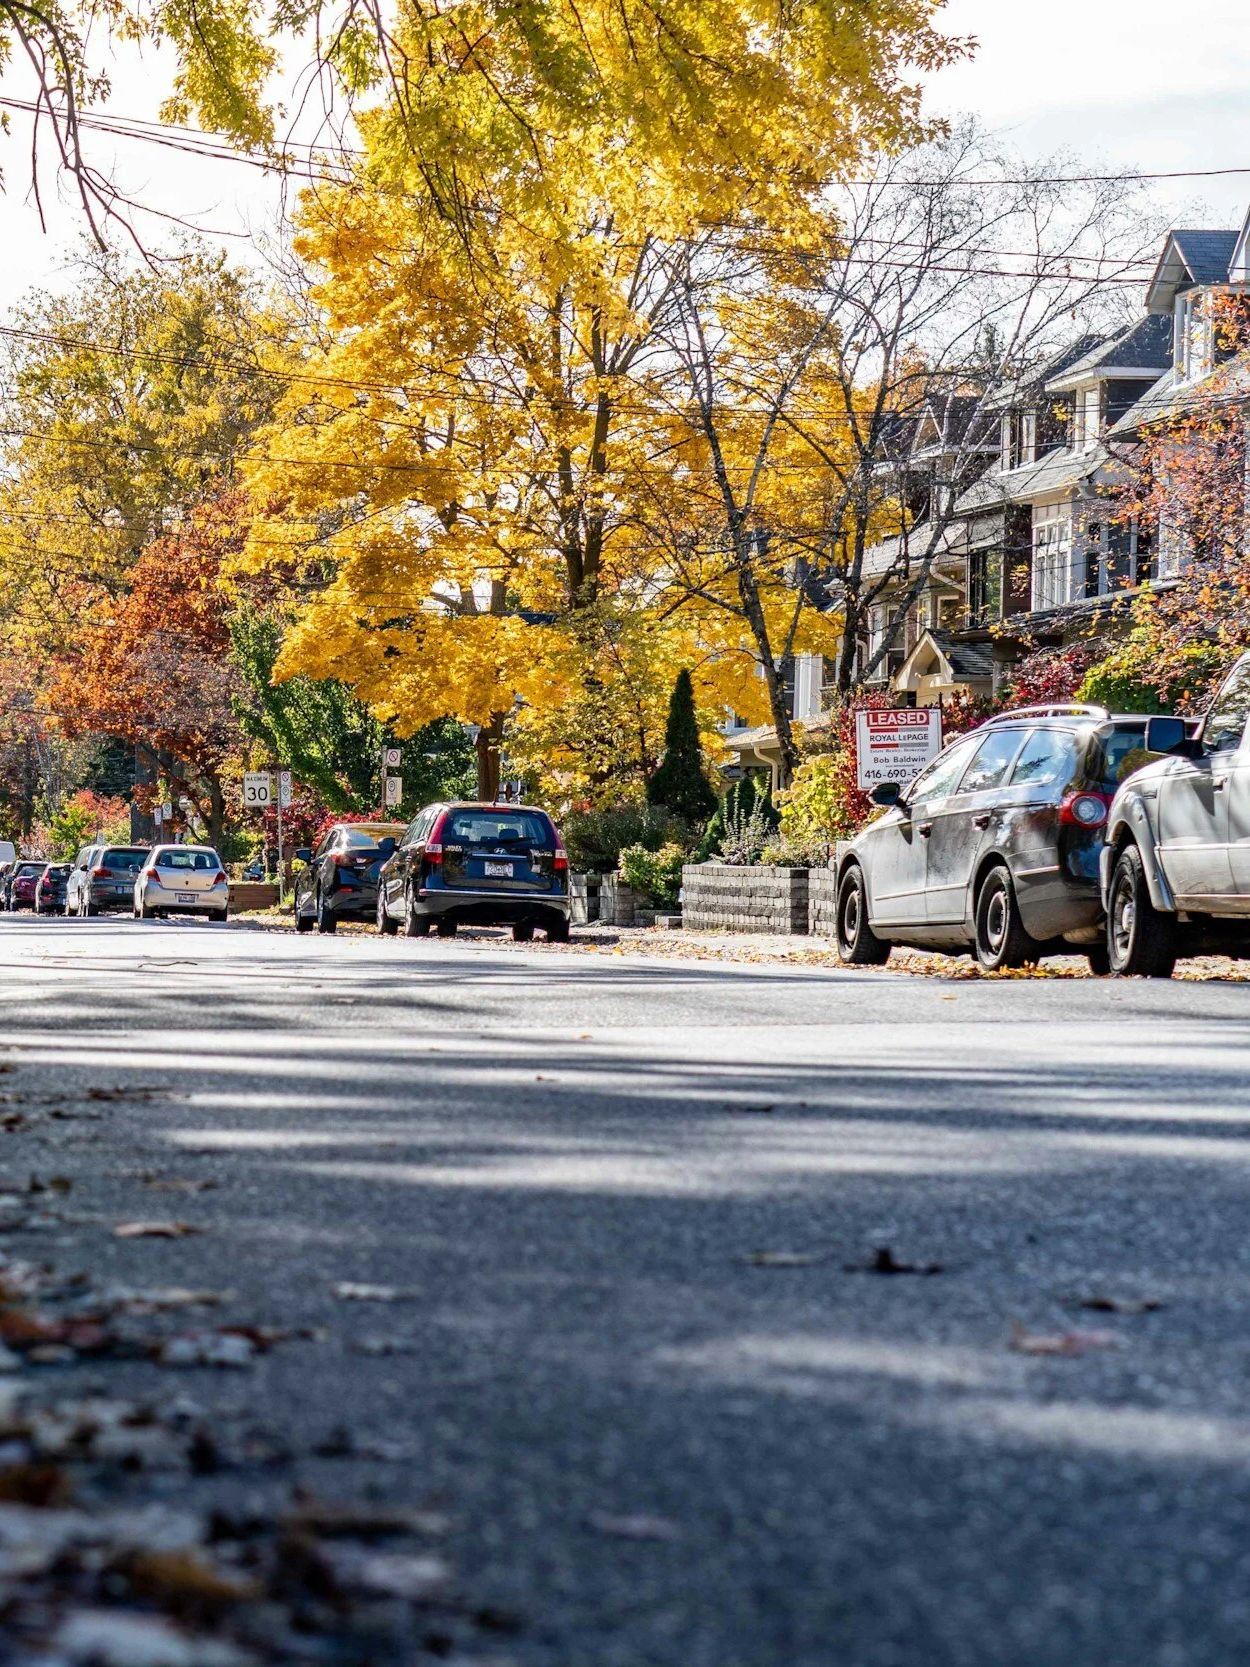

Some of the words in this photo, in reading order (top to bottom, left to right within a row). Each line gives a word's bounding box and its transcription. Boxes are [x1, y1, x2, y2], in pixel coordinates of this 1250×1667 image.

[869, 712, 927, 726] LEASED
[870, 734, 897, 742] ROYAL
[873, 756, 890, 764] Bob
[893, 755, 926, 763] Baldwin
[247, 786, 268, 801] 30
